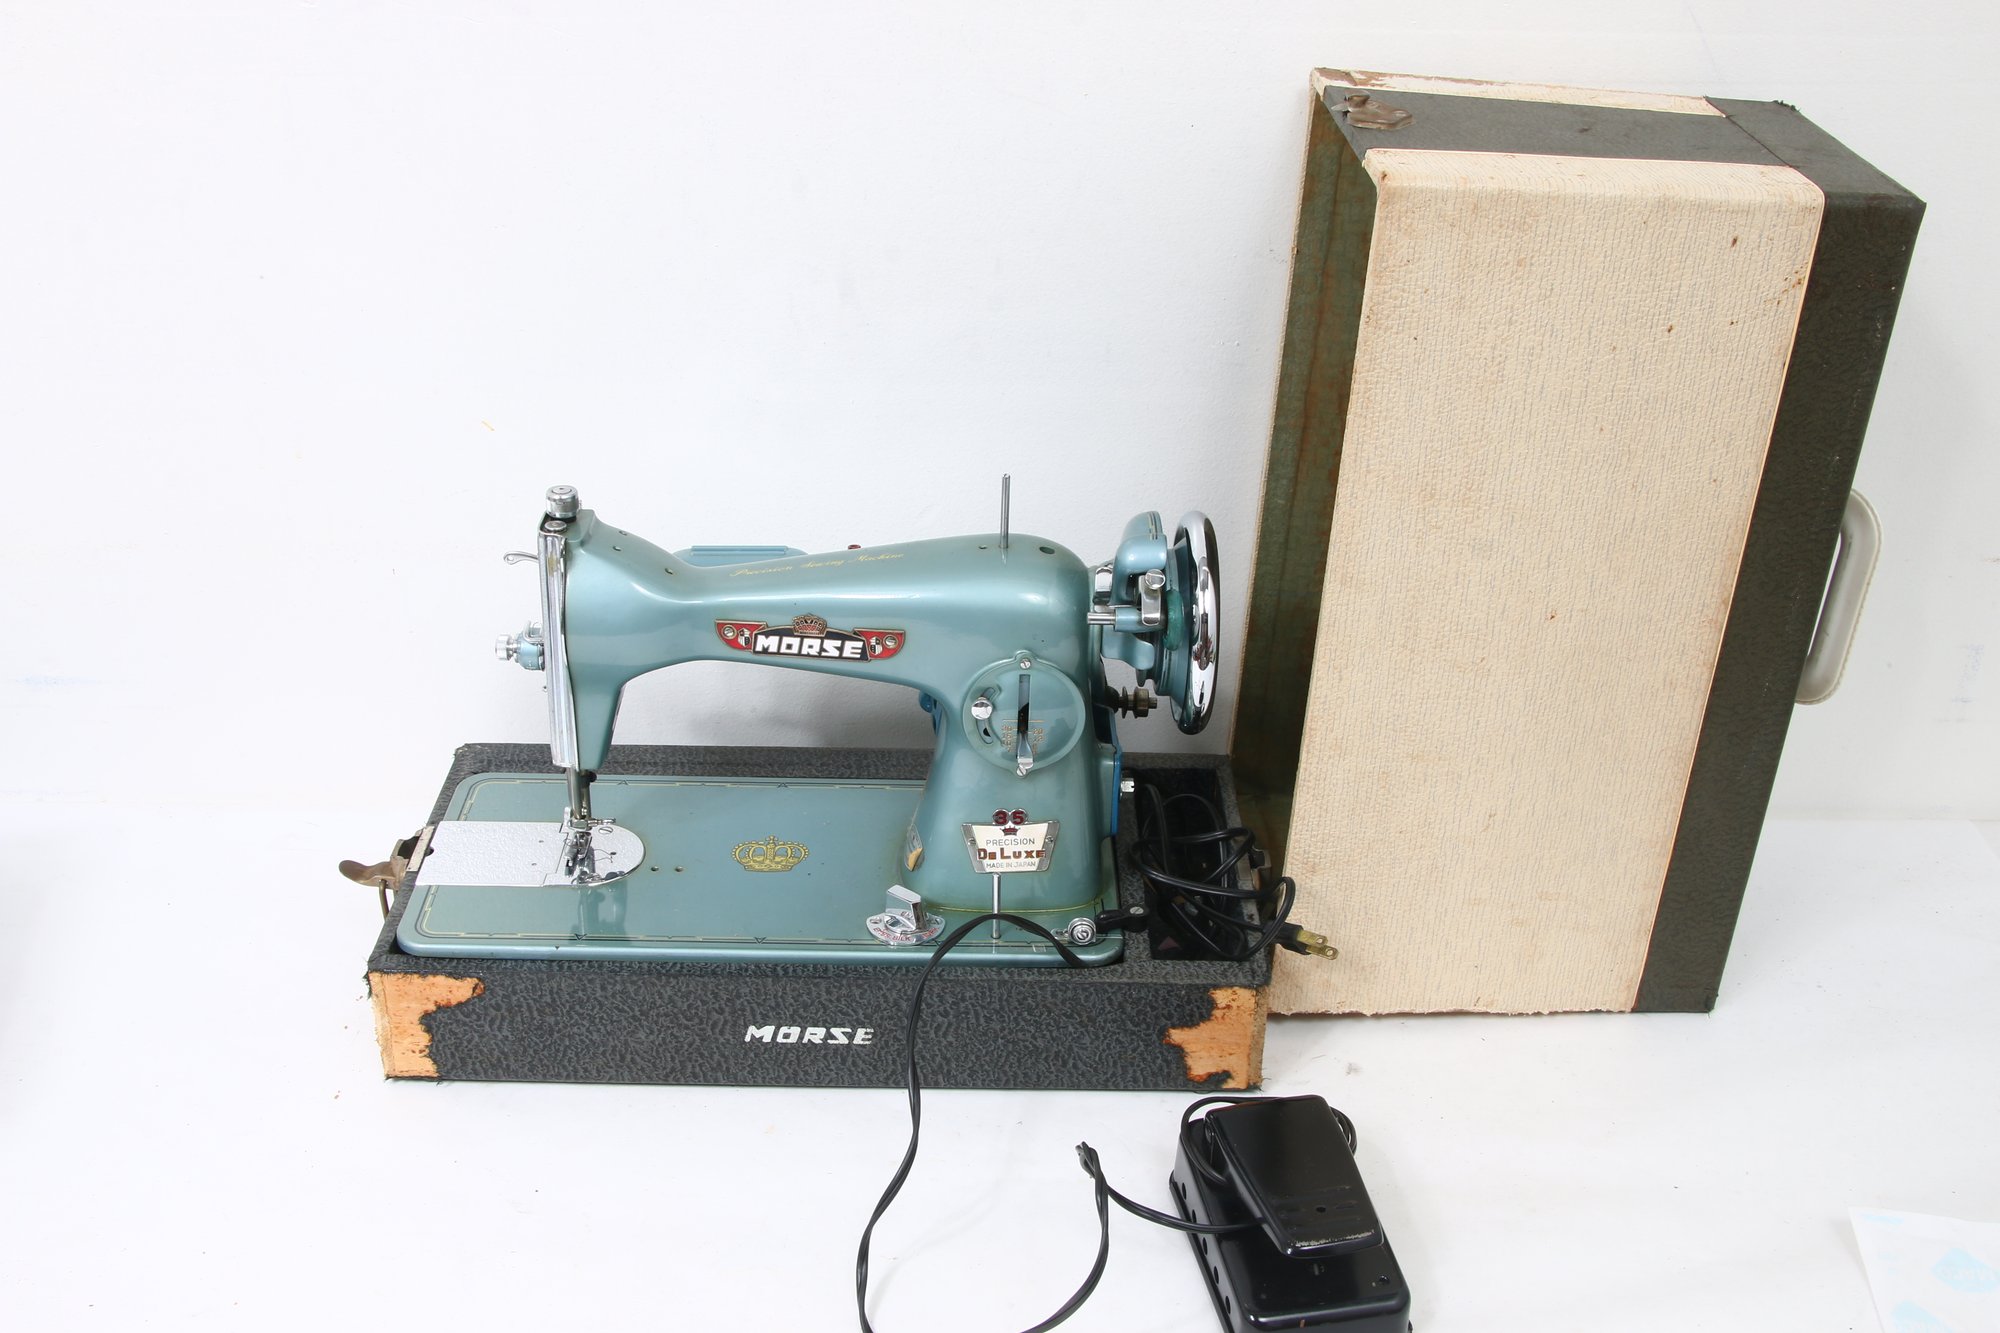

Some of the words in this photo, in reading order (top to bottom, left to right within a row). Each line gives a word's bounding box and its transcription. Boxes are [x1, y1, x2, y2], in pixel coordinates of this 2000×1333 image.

[754, 634, 864, 659] MORSE
[993, 809, 1026, 825] 35
[986, 837, 1035, 847] PRECISION
[1014, 860, 1036, 868] JAPAN
[744, 1025, 875, 1045] MORSE
